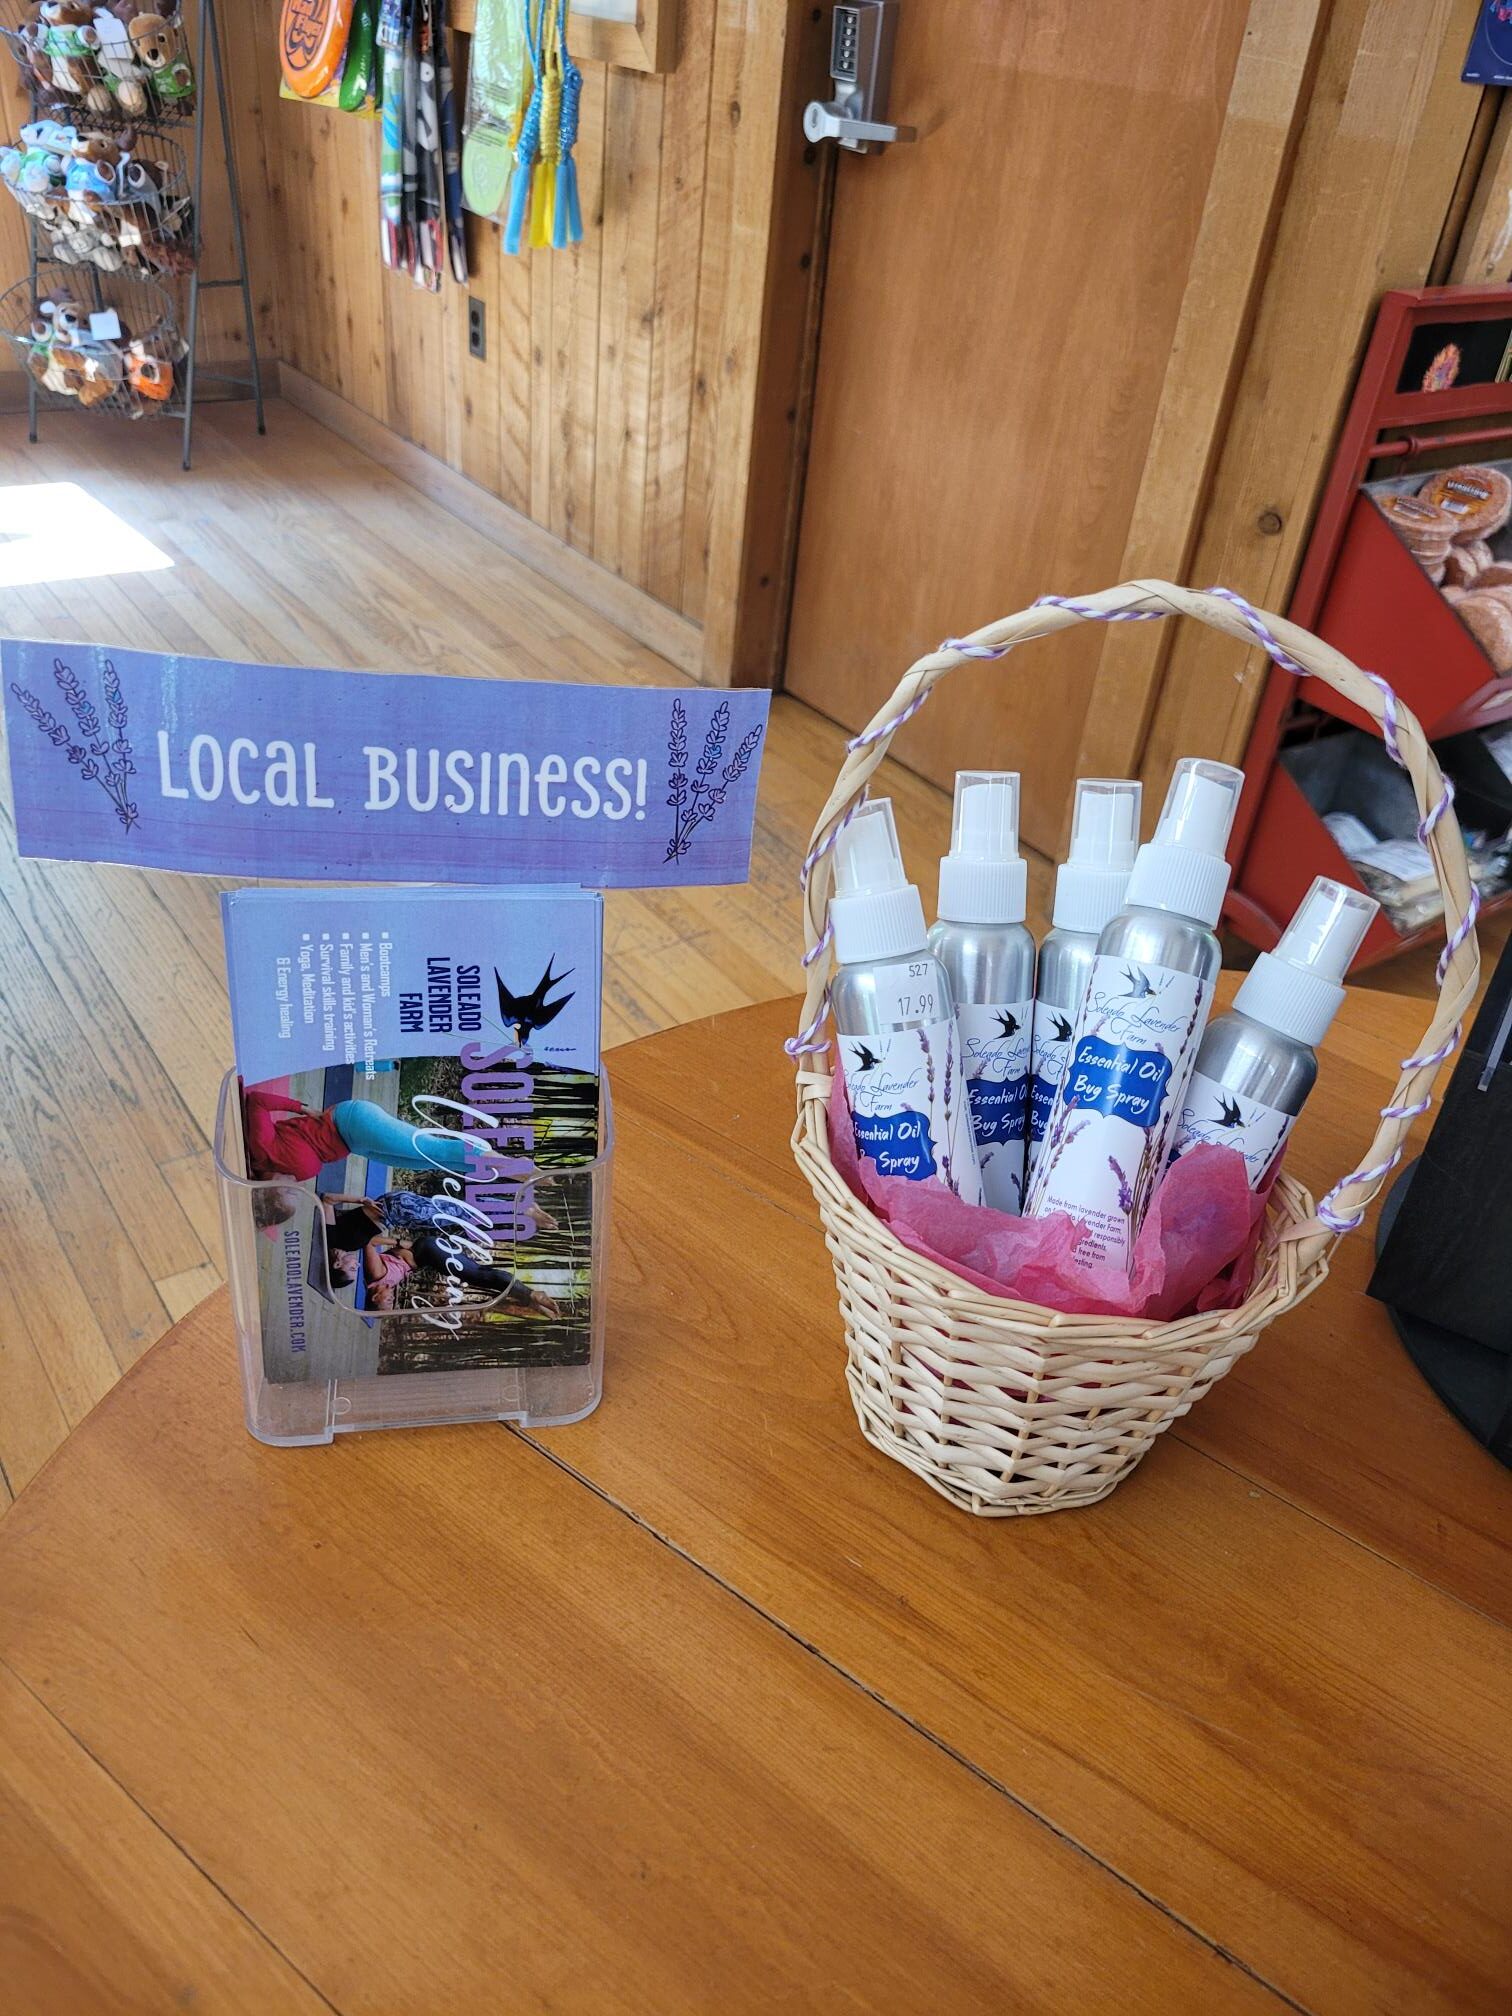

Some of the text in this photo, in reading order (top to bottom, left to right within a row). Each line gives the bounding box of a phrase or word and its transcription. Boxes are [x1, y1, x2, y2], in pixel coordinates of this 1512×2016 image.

[276, 966, 291, 1002] Energy
[378, 942, 393, 997] Bootcamps
[908, 963, 929, 978] 527
[301, 973, 316, 1024] Meditation
[319, 943, 337, 1051] Survival skills training
[338, 943, 358, 1065] Family and kid's activities
[359, 943, 377, 1081] Men's and Woman's Retreats
[399, 993, 424, 1033] FARM
[426, 957, 453, 1034] LAVENDER
[456, 964, 482, 1032] SOLEADO
[898, 993, 934, 1016] 17.99
[278, 1003, 294, 1039] healing
[1110, 1016, 1148, 1046] Farm
[1131, 1006, 1188, 1034] Lavender
[871, 1067, 922, 1095] Lavender
[1077, 1045, 1138, 1075] Essential
[1139, 1061, 1165, 1082] Oil
[859, 1090, 893, 1112] Farm
[967, 1086, 1018, 1105] Essential
[1031, 1084, 1055, 1106] Essen
[1073, 1074, 1151, 1115] Bug Spray
[460, 1042, 536, 1241] SOLEADO
[854, 1120, 921, 1141] Essential Oil
[972, 1114, 998, 1137] Bug
[878, 1151, 920, 1174] Spray
[411, 1094, 500, 1341] Wellbeing
[1063, 1199, 1078, 1211] from
[1079, 1204, 1107, 1220] lavender
[284, 1230, 307, 1353] SOLEADOLAVENDER.COM
